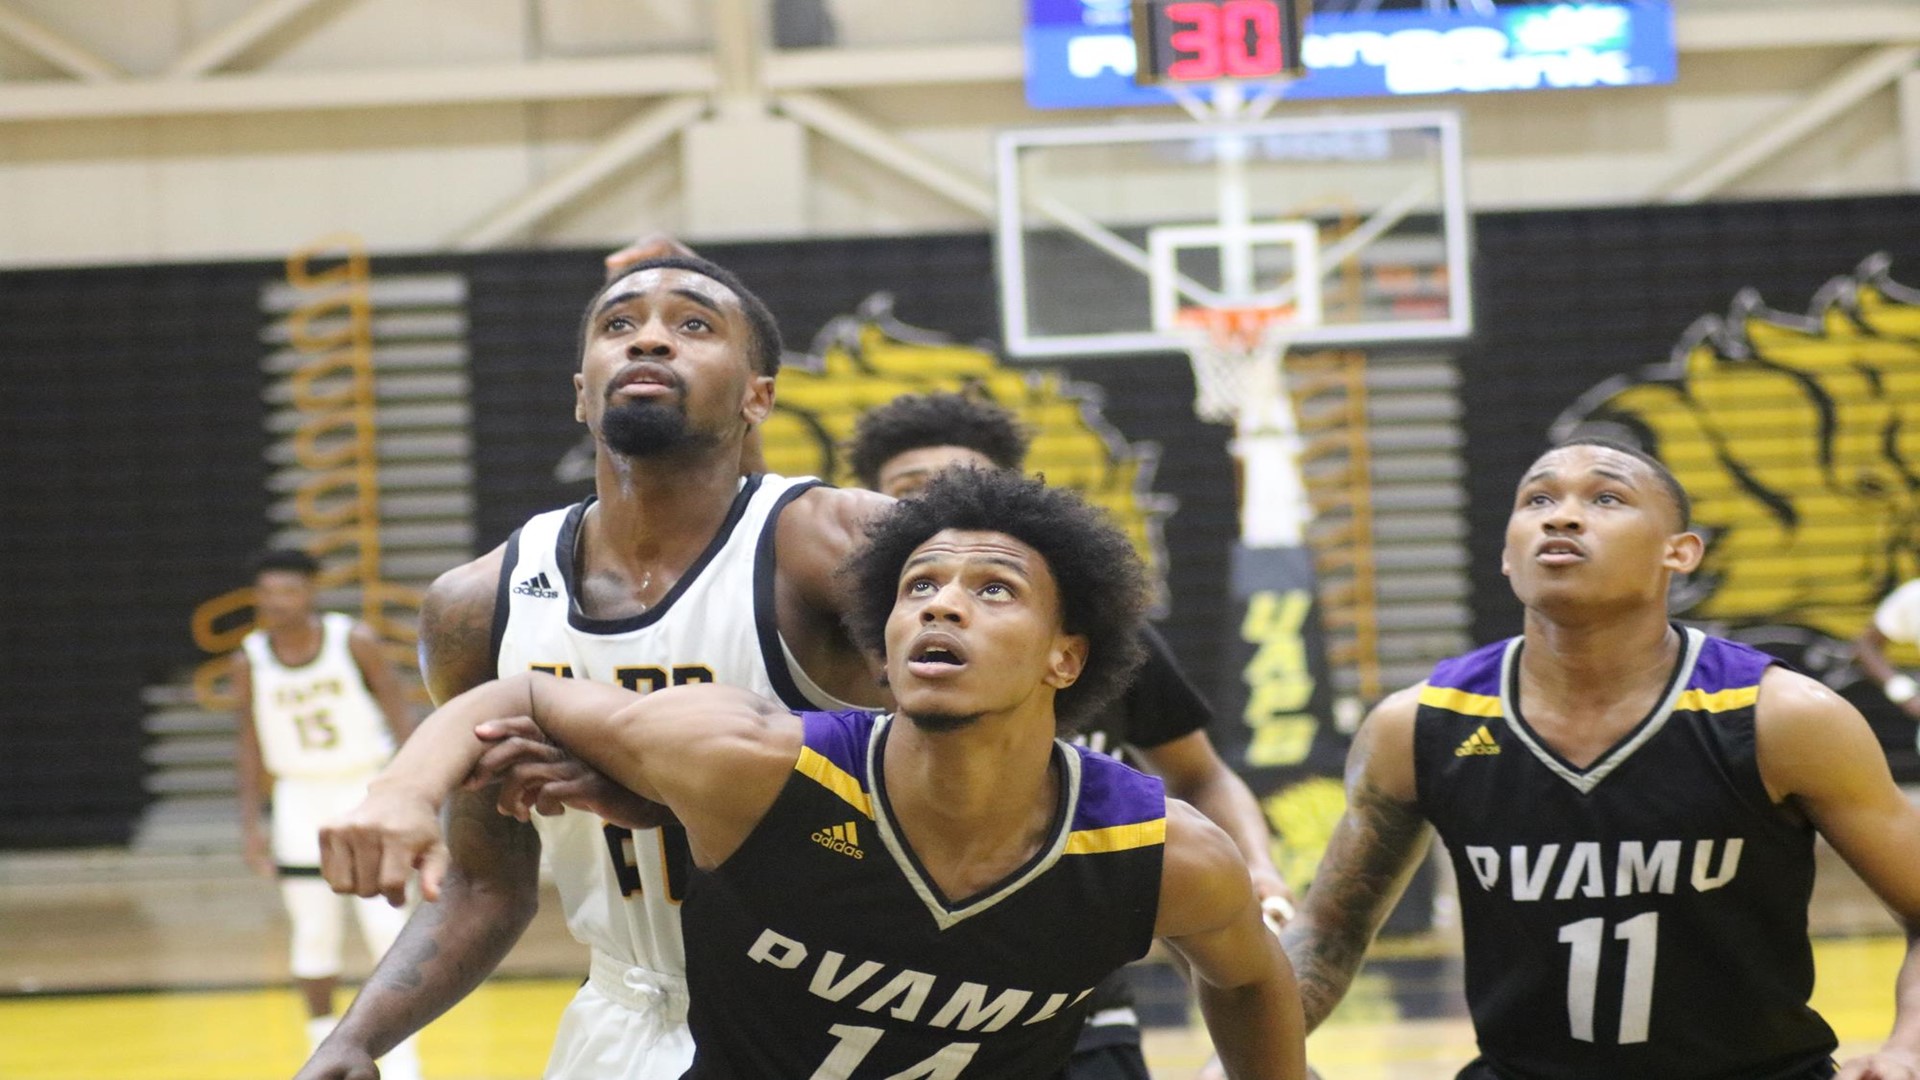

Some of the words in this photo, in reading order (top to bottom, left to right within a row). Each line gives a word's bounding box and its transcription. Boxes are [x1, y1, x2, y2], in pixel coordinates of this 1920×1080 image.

[1165, 0, 1284, 81] 30
[512, 584, 559, 599] adidas
[811, 832, 865, 860] adidas
[1465, 838, 1744, 901] PVAMU
[1558, 911, 1659, 1045] 11
